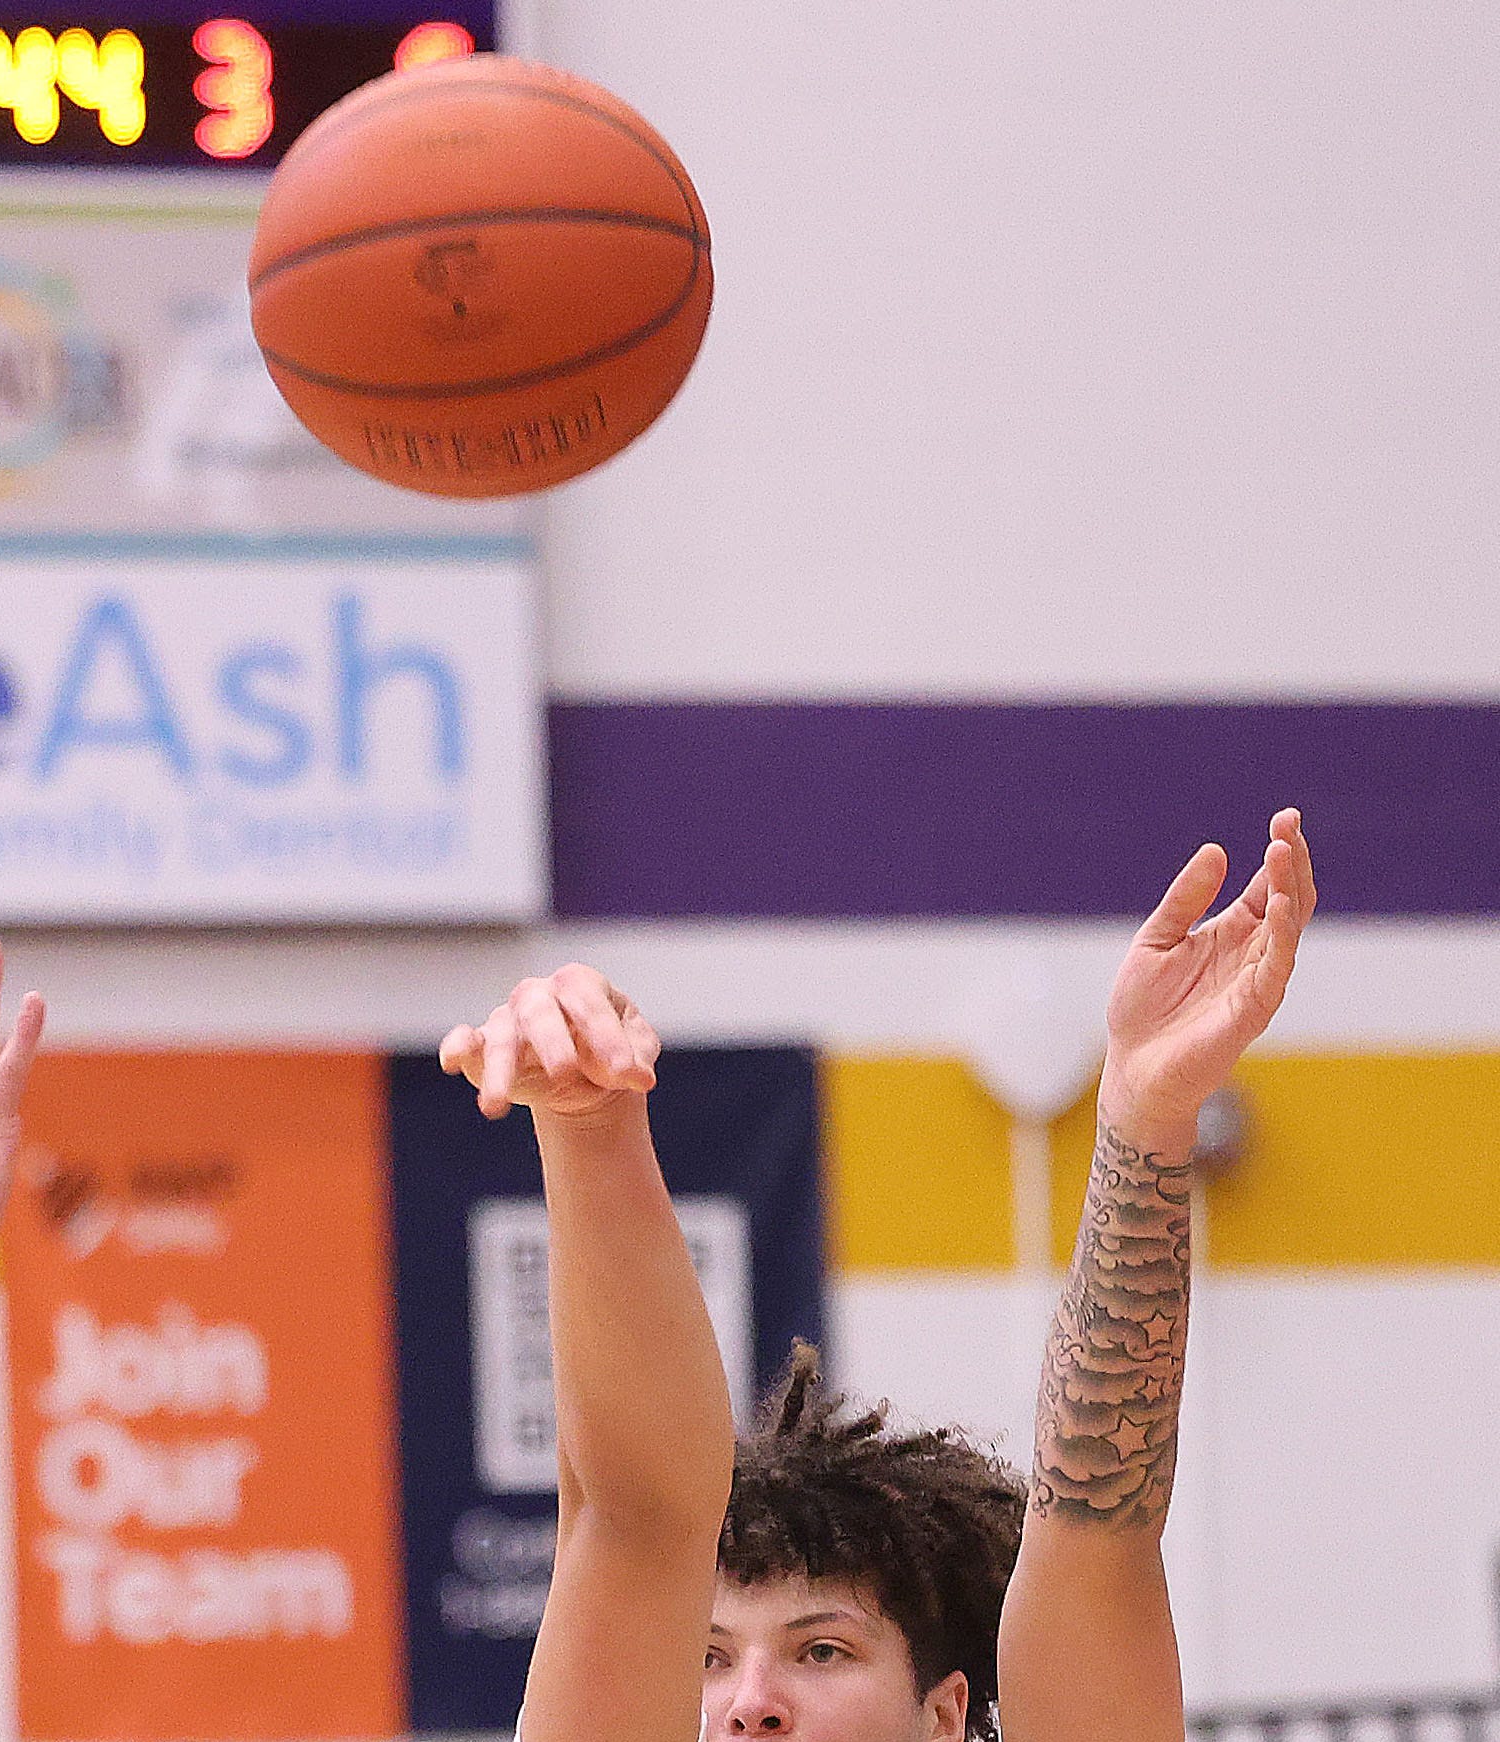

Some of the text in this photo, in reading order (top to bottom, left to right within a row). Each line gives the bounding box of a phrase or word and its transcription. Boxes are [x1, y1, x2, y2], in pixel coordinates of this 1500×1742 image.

[192, 19, 274, 159] 3
[38, 1304, 267, 1417] Join
[37, 1420, 259, 1530] Our
[36, 1530, 354, 1645] Team
